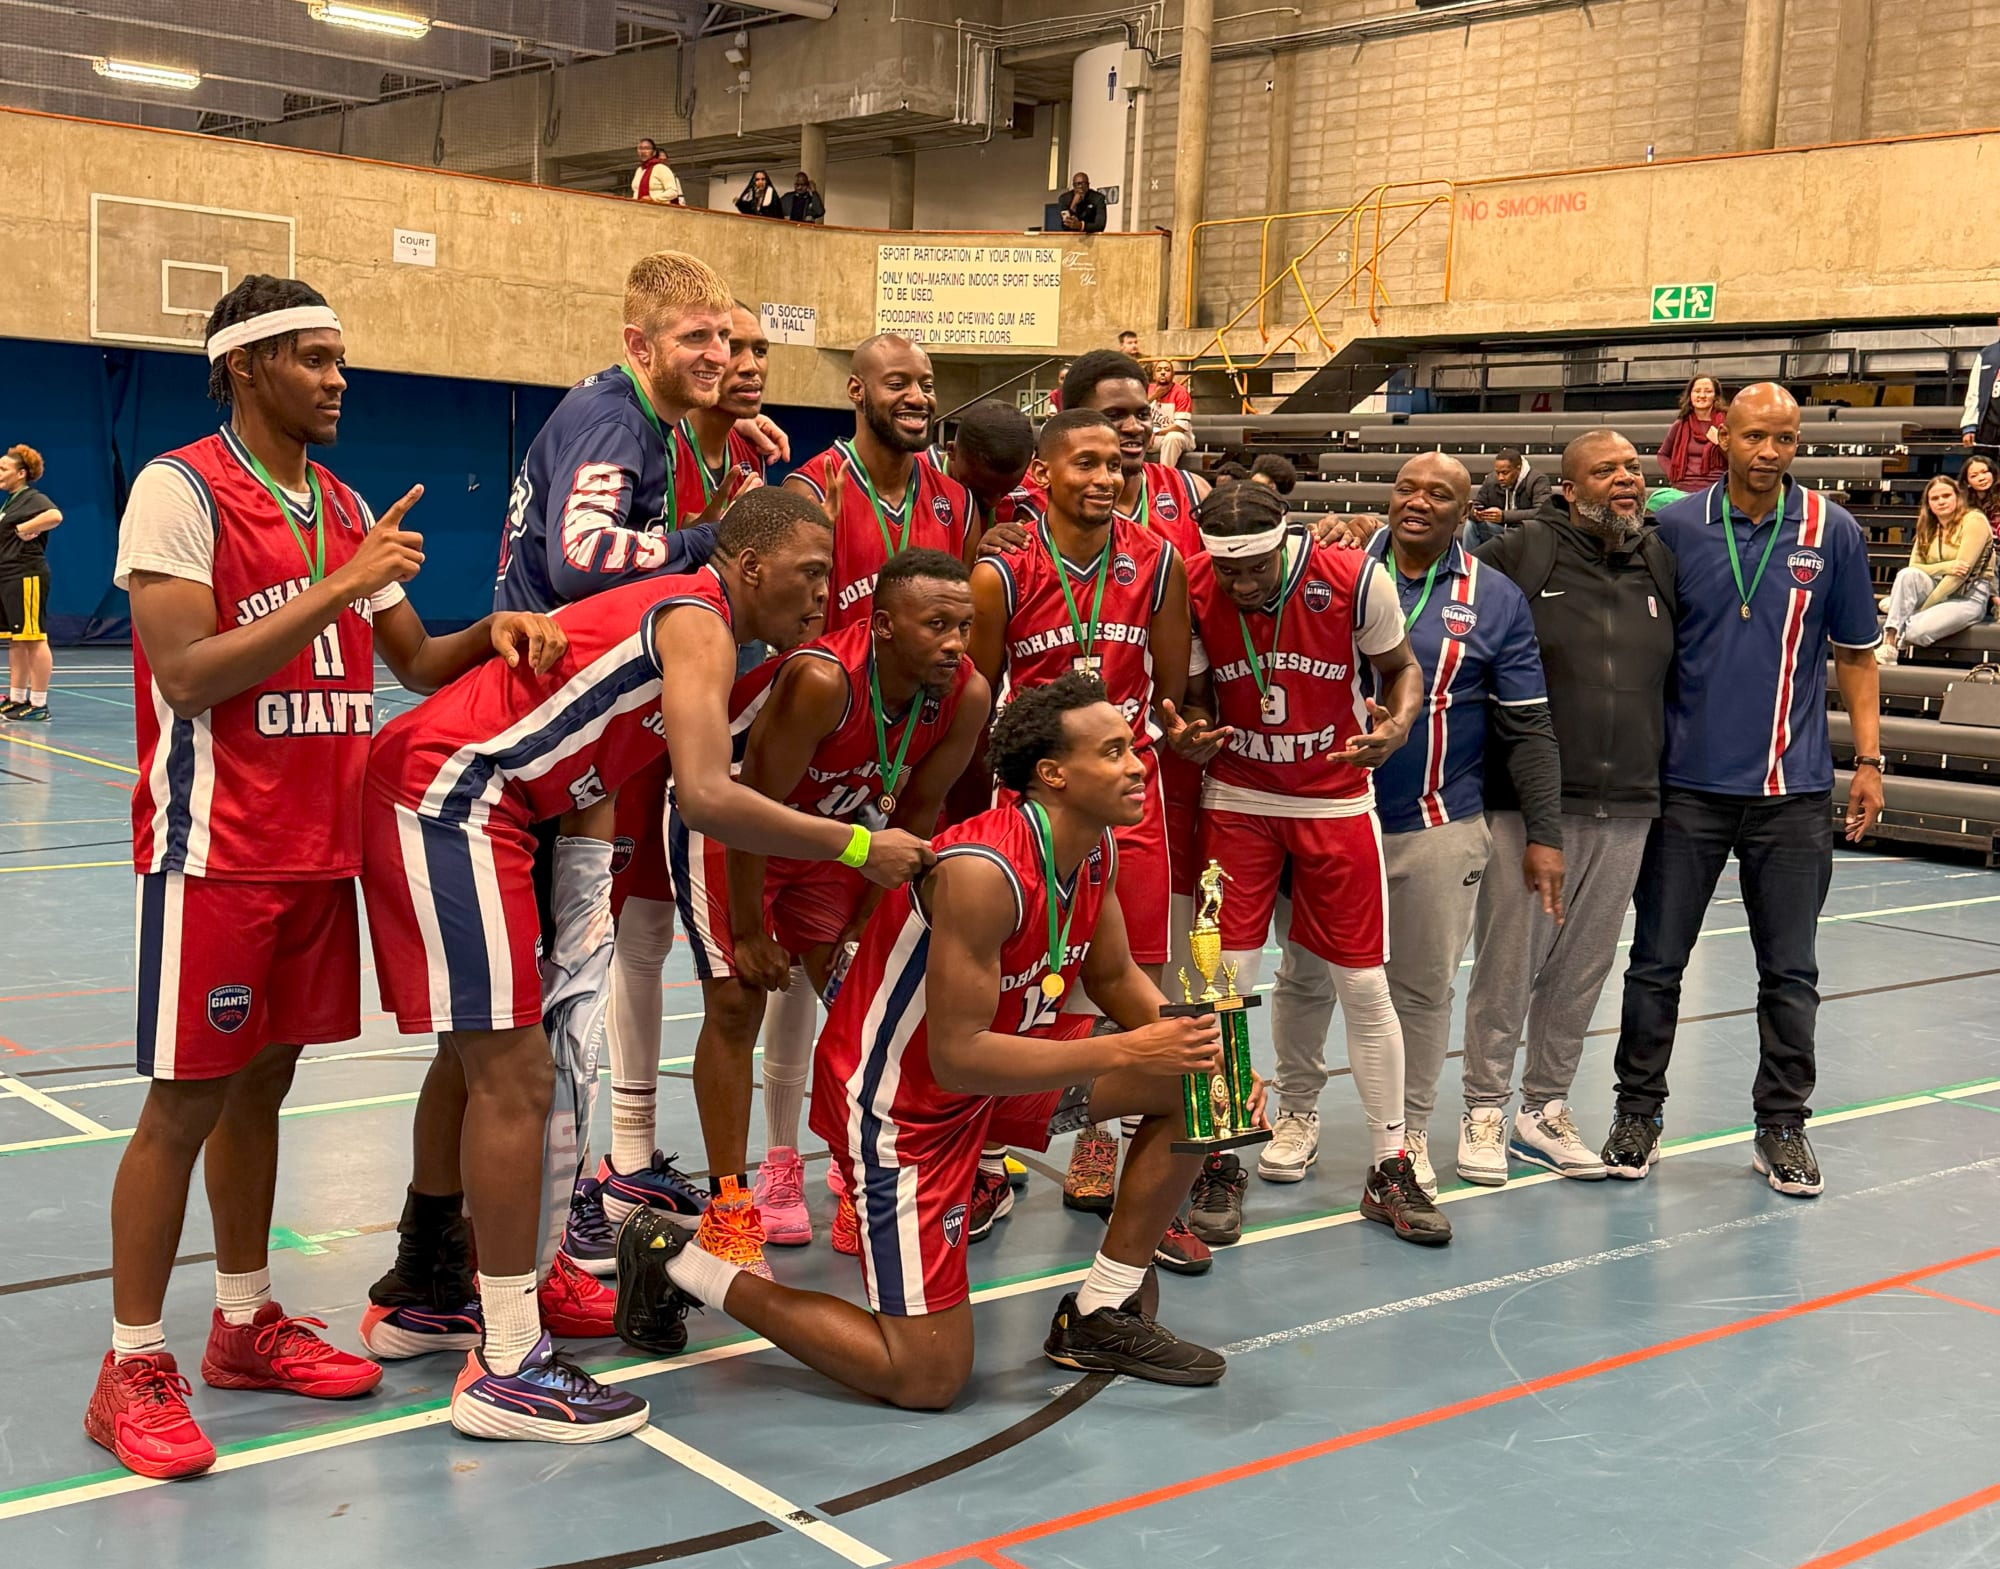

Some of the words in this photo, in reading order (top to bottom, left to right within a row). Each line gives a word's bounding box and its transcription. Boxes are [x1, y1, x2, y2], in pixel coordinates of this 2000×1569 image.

[1462, 201, 1489, 221] NO
[1496, 191, 1587, 218] SMOKING
[400, 235, 430, 247] COURT
[883, 247, 910, 261] SPORT
[914, 248, 971, 263] PARTICIPATION
[975, 249, 984, 262] AT
[989, 249, 1009, 263] YOUR
[1013, 250, 1032, 263] OWN
[1035, 250, 1057, 263] RISK.
[882, 271, 903, 285] ONLY
[906, 272, 965, 287] NON-MARKING
[968, 273, 999, 287] INDOOR
[1002, 274, 1029, 287] SPORT
[1032, 274, 1061, 288] SHOES
[883, 288, 893, 301] TO
[897, 288, 907, 301] BE
[911, 288, 935, 302] USED.
[761, 303, 775, 316] NO
[778, 305, 816, 320] SOCCER
[937, 311, 954, 325] AND
[957, 311, 995, 326] CHEWING
[998, 312, 1015, 326] GUM
[1019, 312, 1036, 326] ARE
[770, 317, 778, 329] IN
[782, 318, 805, 332] HALL
[784, 332, 788, 343] 1
[929, 329, 941, 342] ON
[944, 329, 976, 343] SPORTS
[1789, 556, 1822, 570] GIANTS
[1443, 609, 1476, 625] GIANTS
[313, 623, 345, 677] 11
[257, 692, 374, 736] GIANT
[211, 994, 249, 1008] GIANTS
